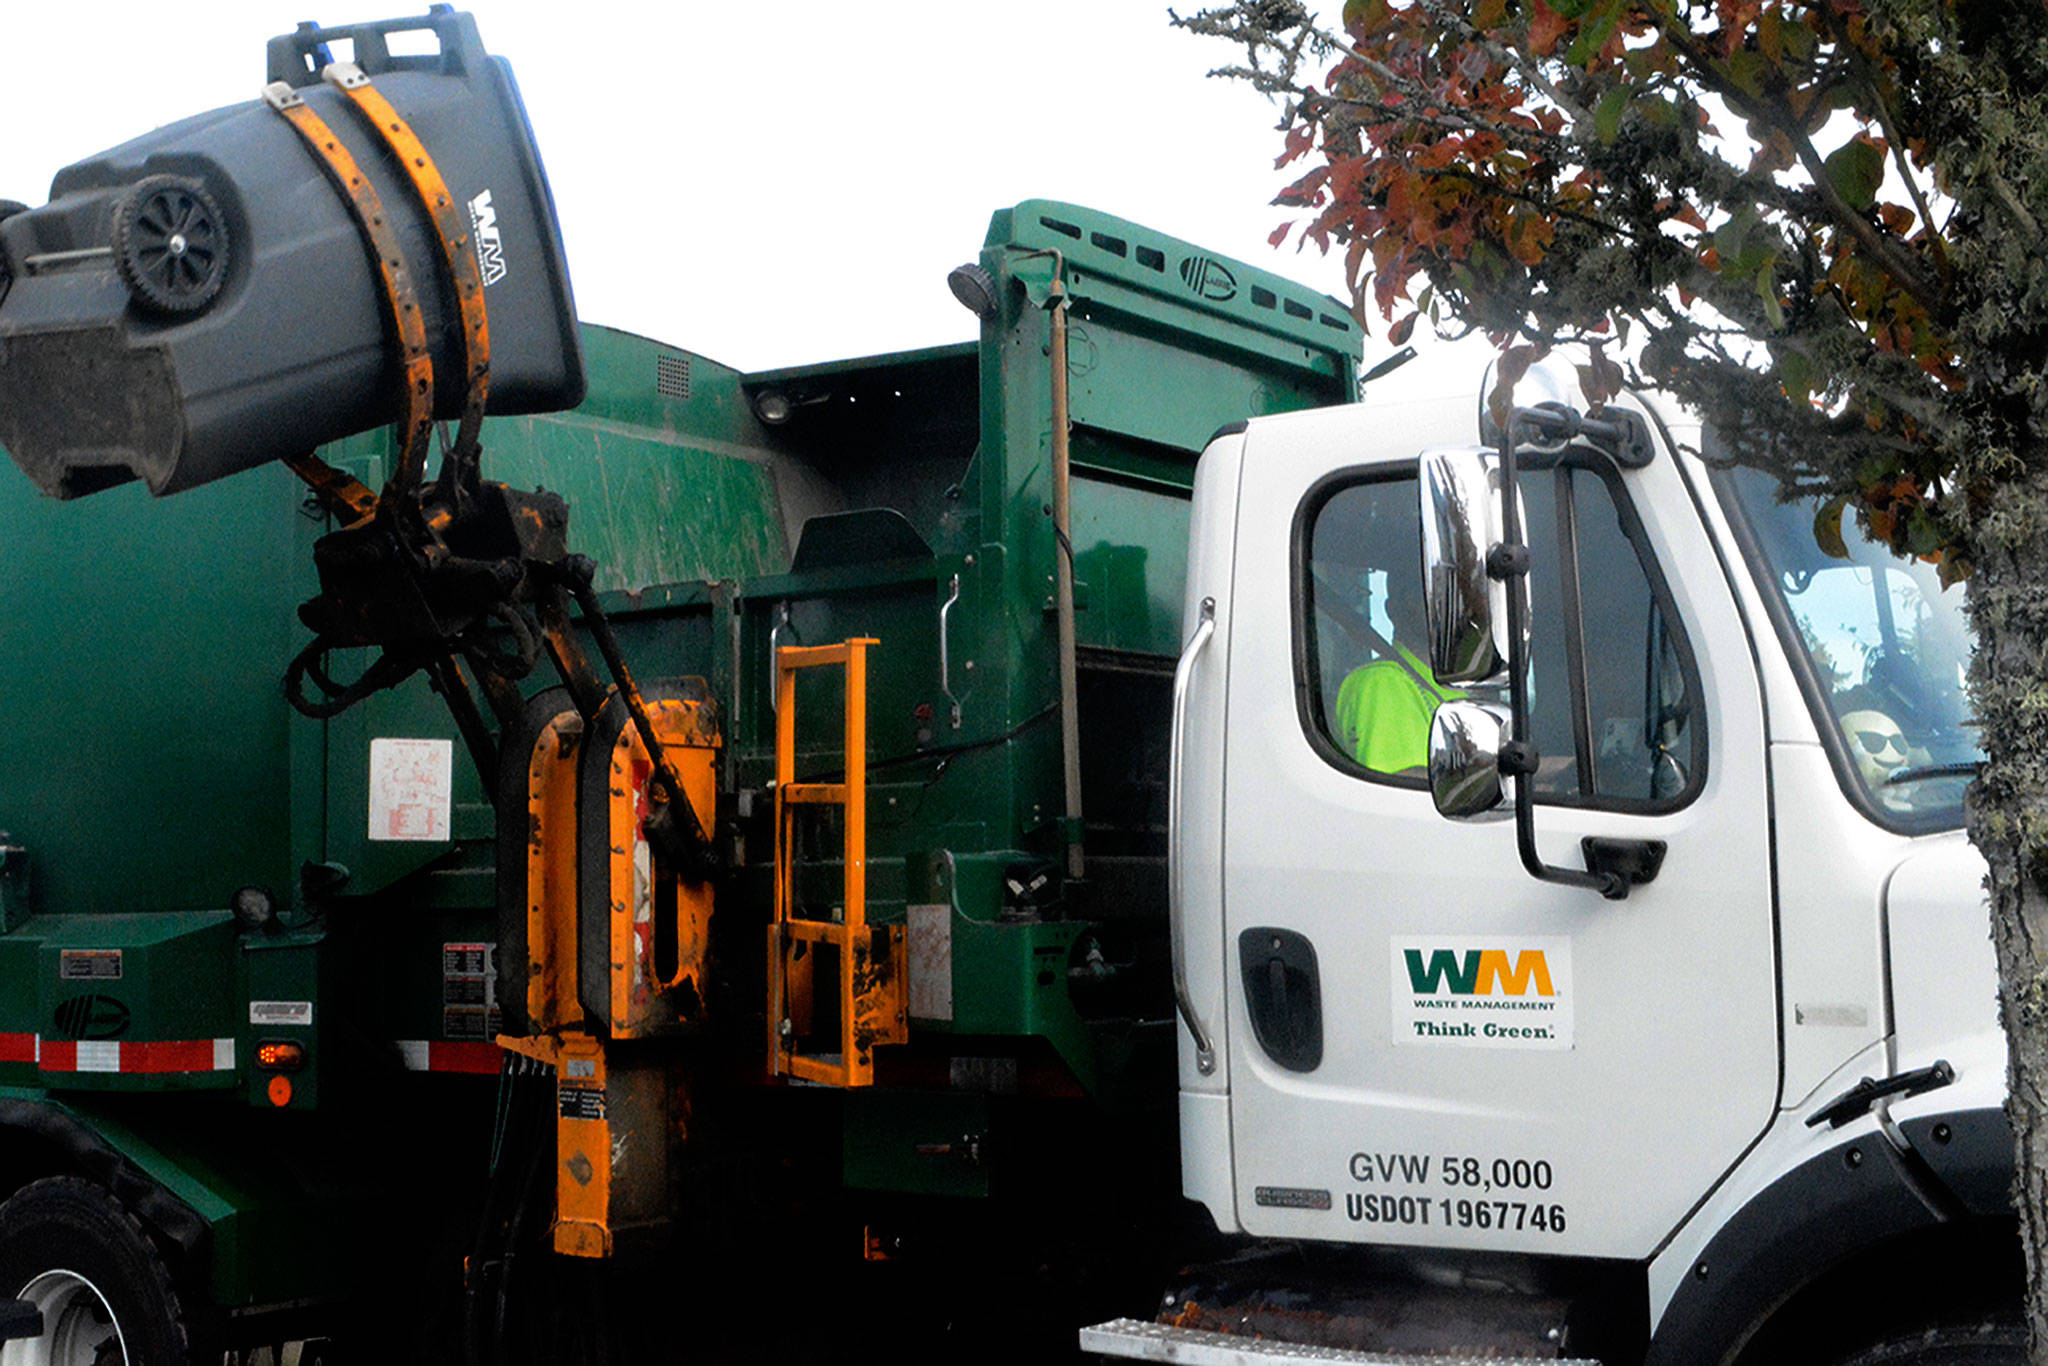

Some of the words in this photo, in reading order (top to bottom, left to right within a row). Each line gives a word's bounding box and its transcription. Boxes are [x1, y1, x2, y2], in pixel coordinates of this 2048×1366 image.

[472, 188, 507, 285] WM
[1403, 948, 1555, 996] WM
[1414, 999, 1457, 1009] WASTE
[1461, 1000, 1555, 1011] MANAGEMENT
[1413, 1021, 1476, 1037] Think
[1349, 1152, 1430, 1183] GVW
[1442, 1156, 1552, 1192] 58,000
[1346, 1193, 1432, 1225] USDOT
[1440, 1199, 1566, 1233] 1967746
